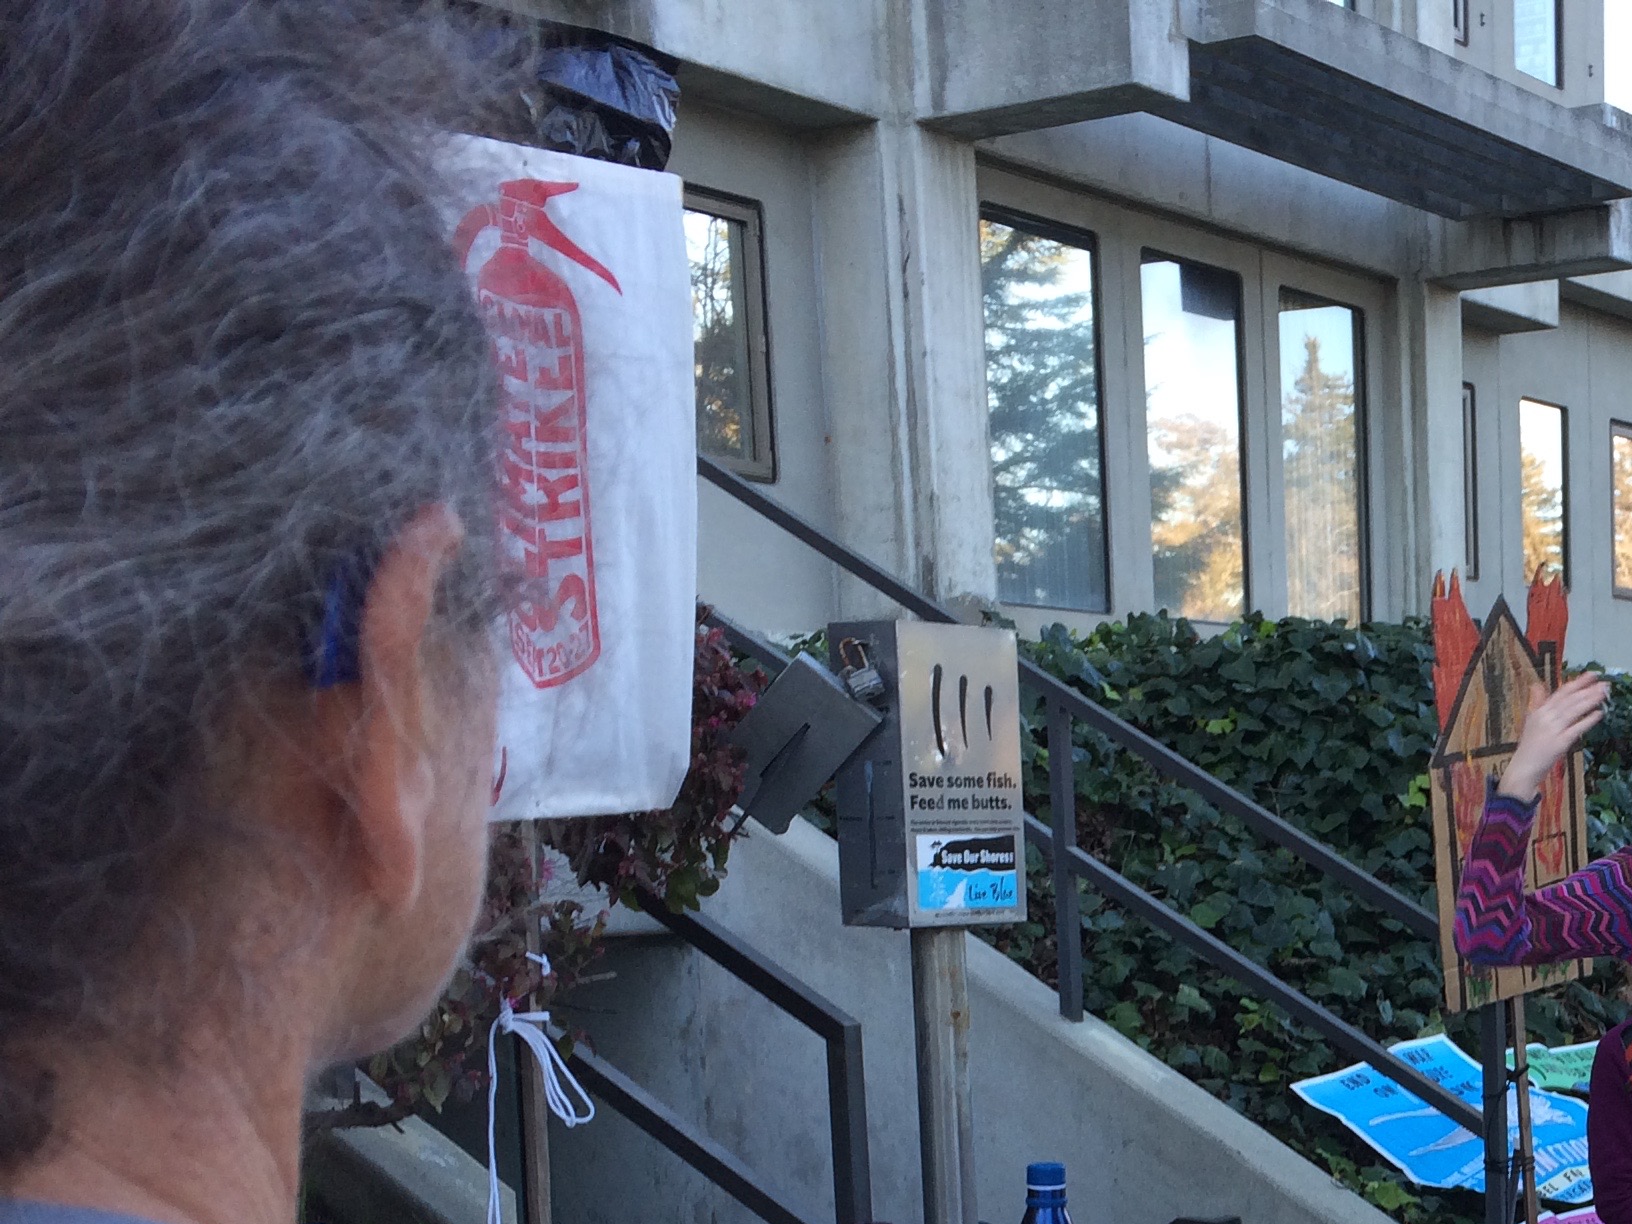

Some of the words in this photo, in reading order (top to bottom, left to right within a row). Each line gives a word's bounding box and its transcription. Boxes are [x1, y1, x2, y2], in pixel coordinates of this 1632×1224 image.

[519, 353, 587, 632] STRIKE
[909, 772, 944, 788] Save
[947, 775, 984, 788] some
[986, 771, 1017, 788] fish.
[910, 794, 944, 810] Feed
[948, 797, 968, 810] me
[972, 794, 1012, 810] butts.
[941, 849, 962, 864] Save
[963, 849, 980, 864] Our
